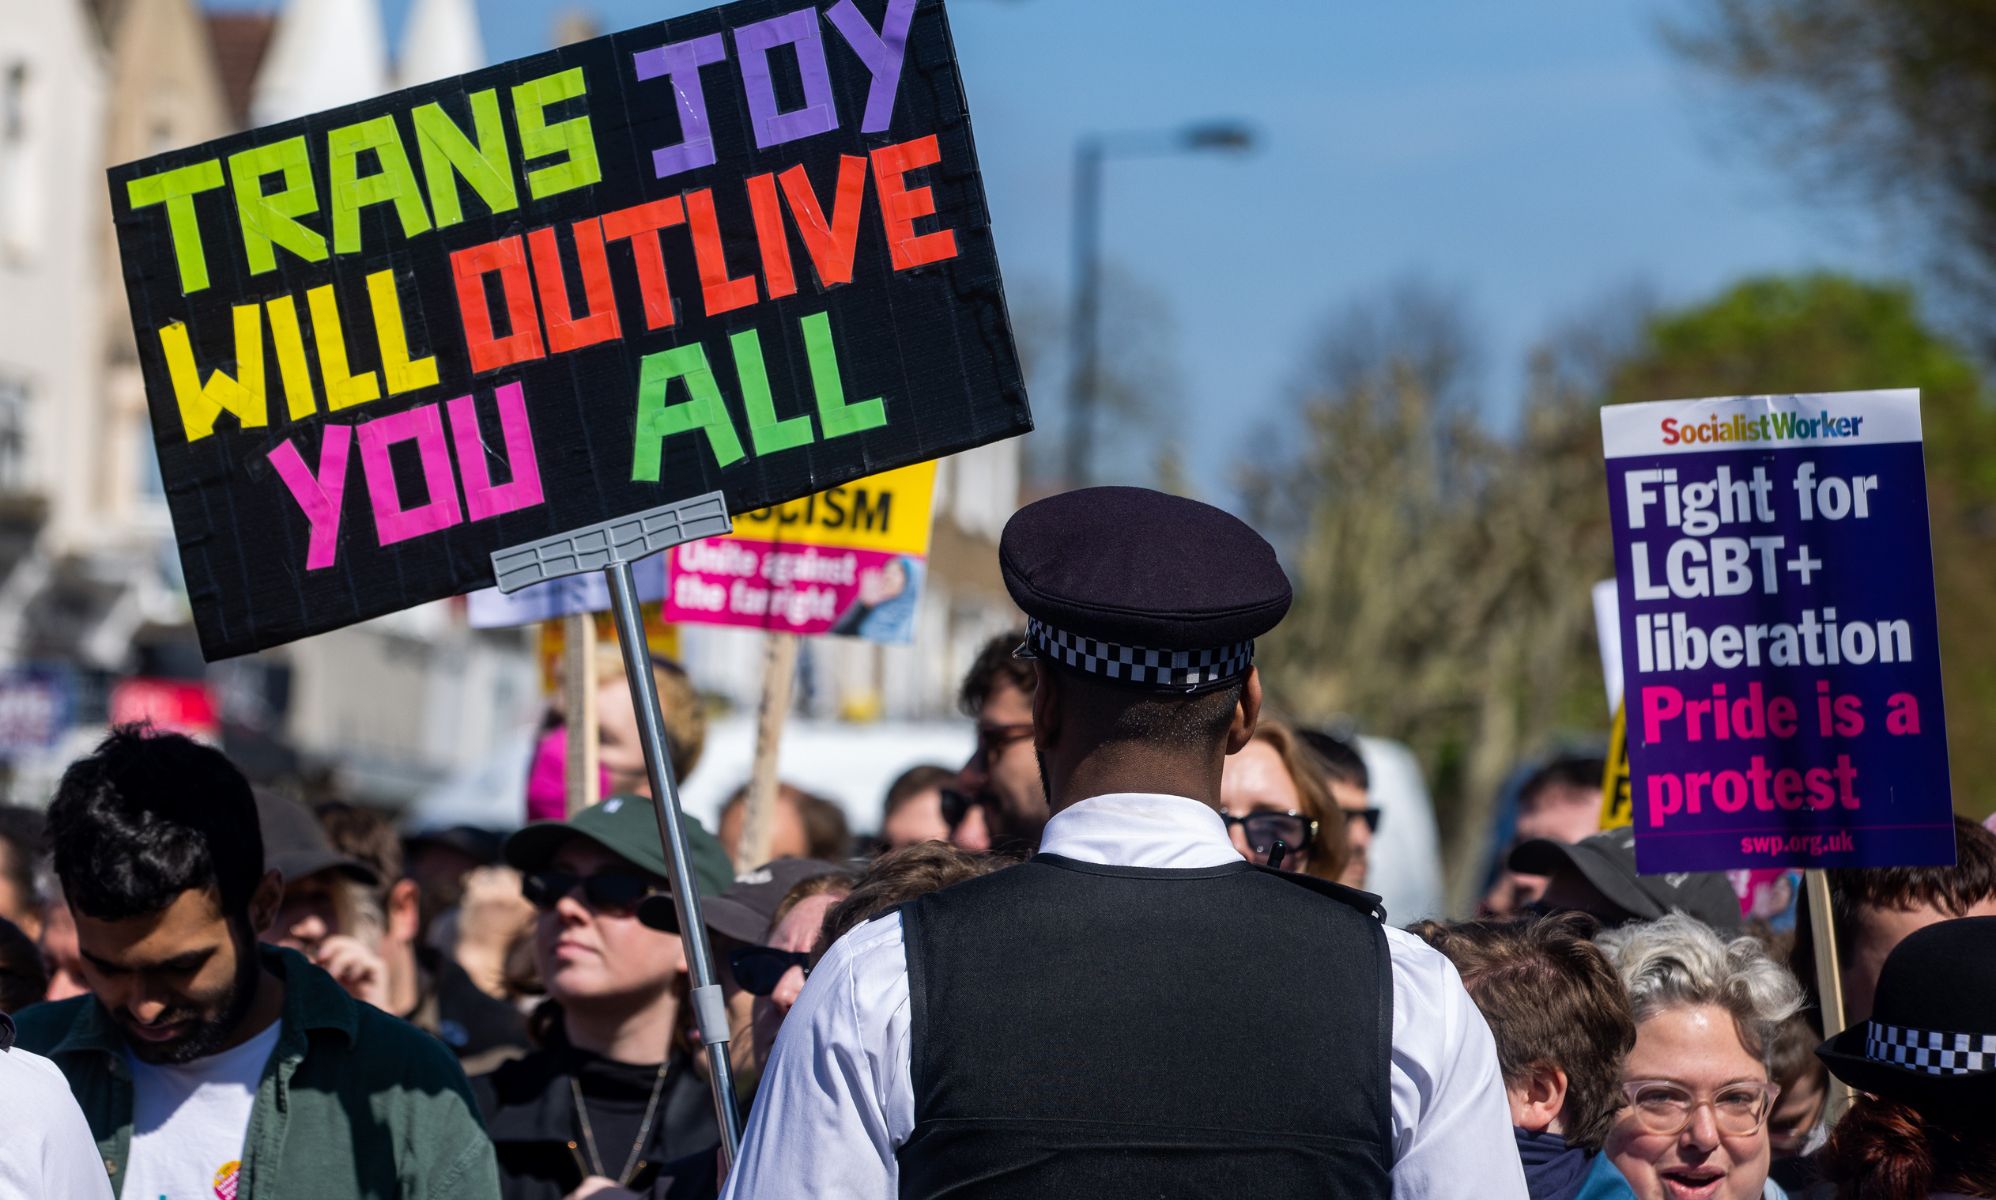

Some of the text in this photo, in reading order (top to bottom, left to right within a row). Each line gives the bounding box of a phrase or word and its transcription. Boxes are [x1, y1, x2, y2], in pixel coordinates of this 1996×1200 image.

[126, 0, 917, 295] TRANS JOY
[158, 133, 959, 443] WILL OUTLIVE
[267, 311, 888, 571] YOU ALL
[1624, 461, 1879, 537] Fight for
[678, 540, 857, 588] Unite against
[1630, 534, 1823, 602] LGBT+
[673, 573, 837, 626] the far right
[1634, 606, 1913, 674] liberation
[1641, 681, 1799, 744] Pride
[1816, 680, 1866, 738] is
[1885, 692, 1922, 736] a
[1647, 754, 1861, 828] protest
[1740, 830, 1855, 858] swp.org.uk
